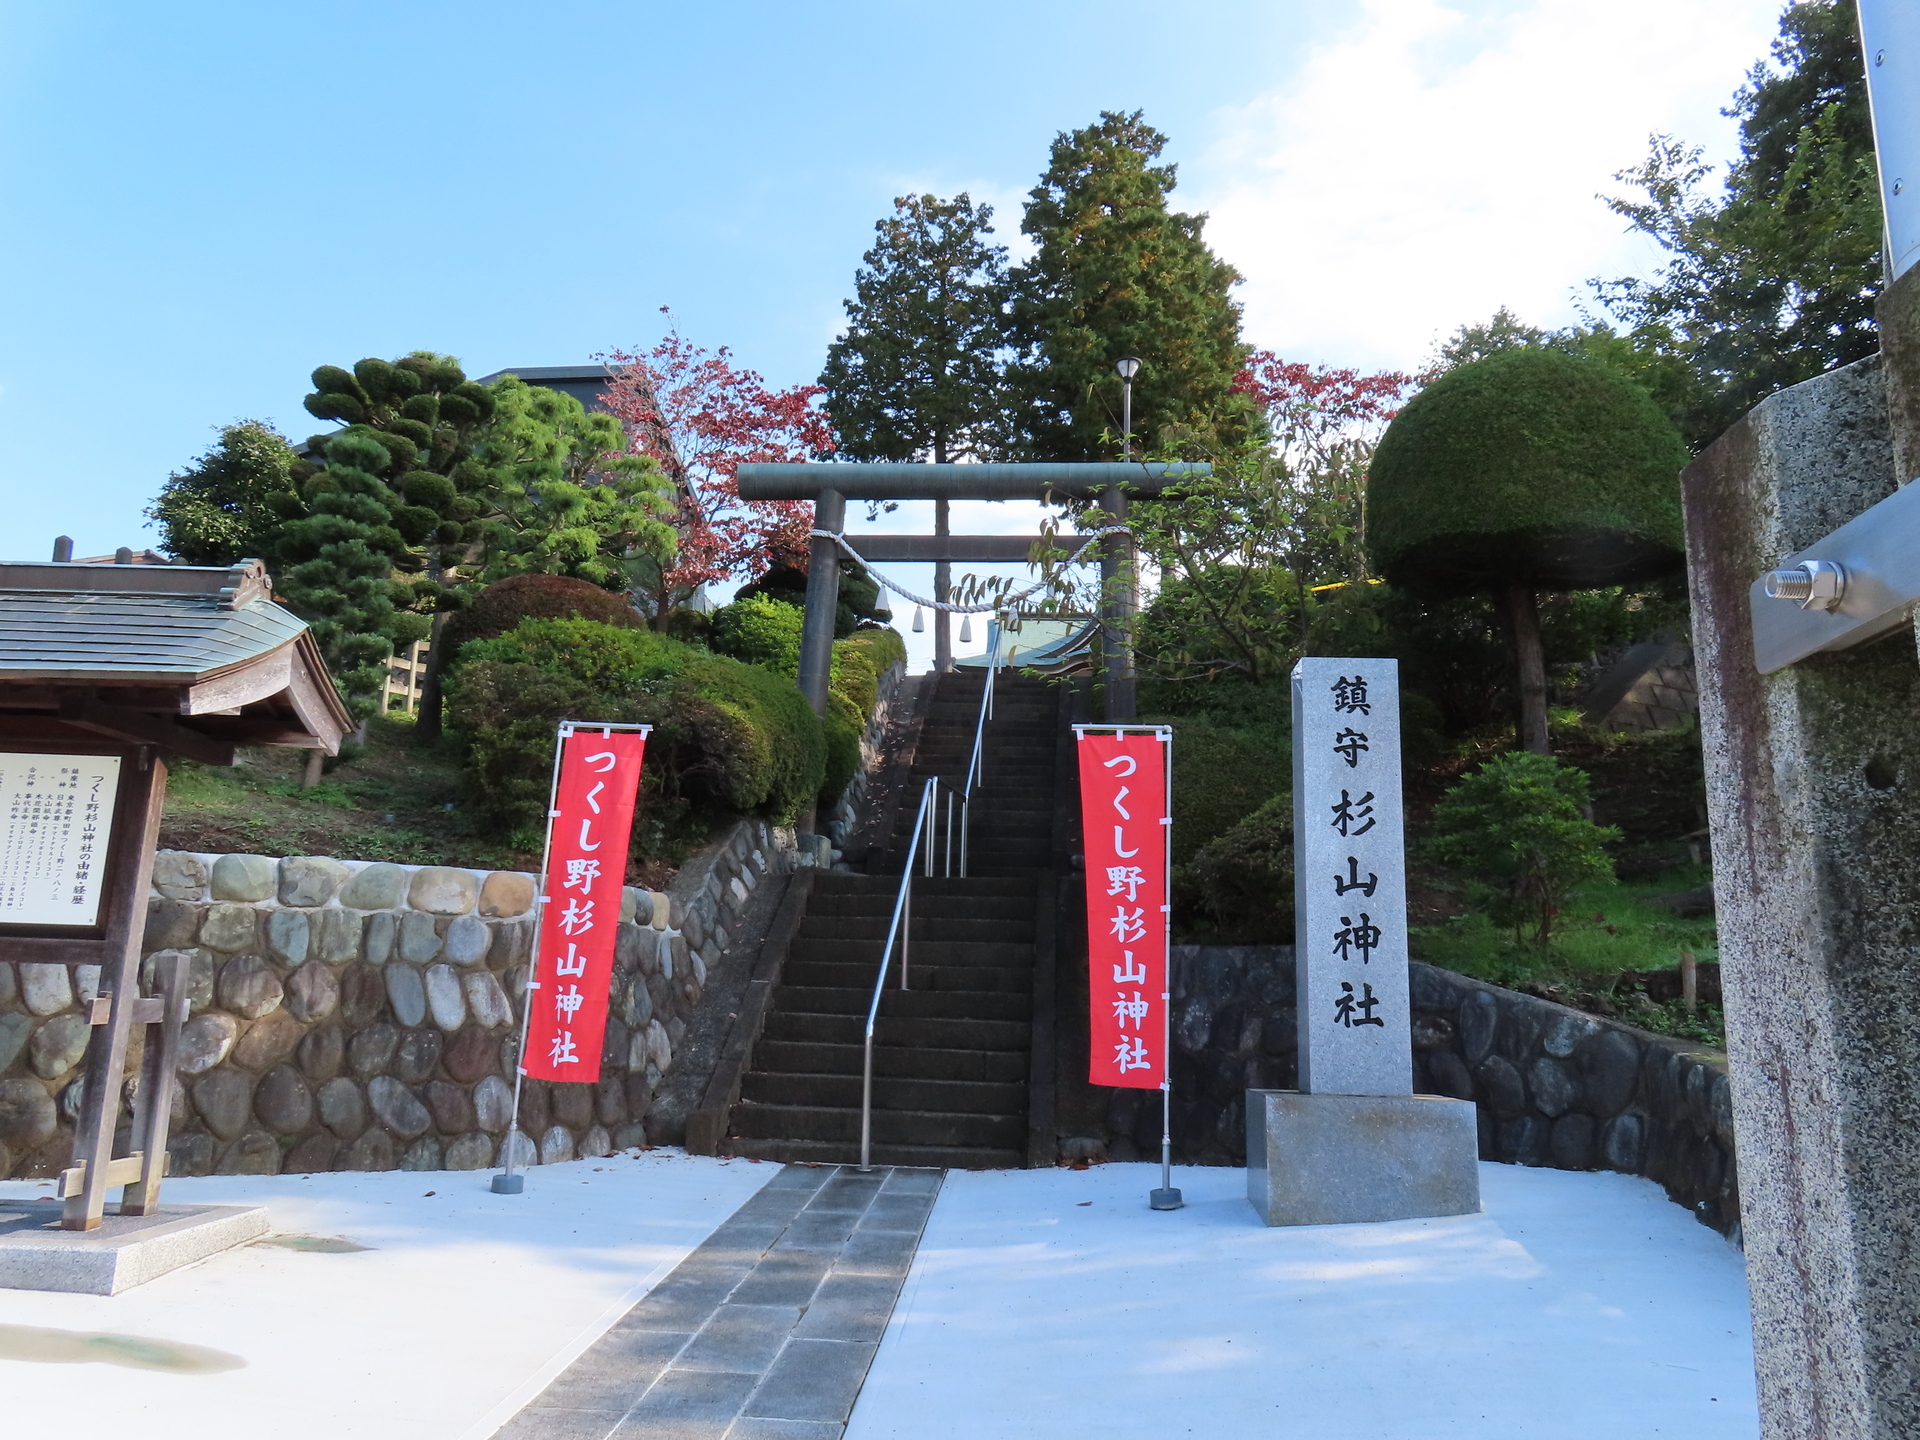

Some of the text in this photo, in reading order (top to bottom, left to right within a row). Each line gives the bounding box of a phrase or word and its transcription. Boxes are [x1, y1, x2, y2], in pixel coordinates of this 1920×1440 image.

[71, 775, 105, 905] つくし野杉山神社の由緒・経歴
[548, 751, 617, 1069] つくし野杉山神社
[1103, 754, 1152, 1075] つくし野杉山神社
[1330, 675, 1385, 1029] 鎮守杉山神社
